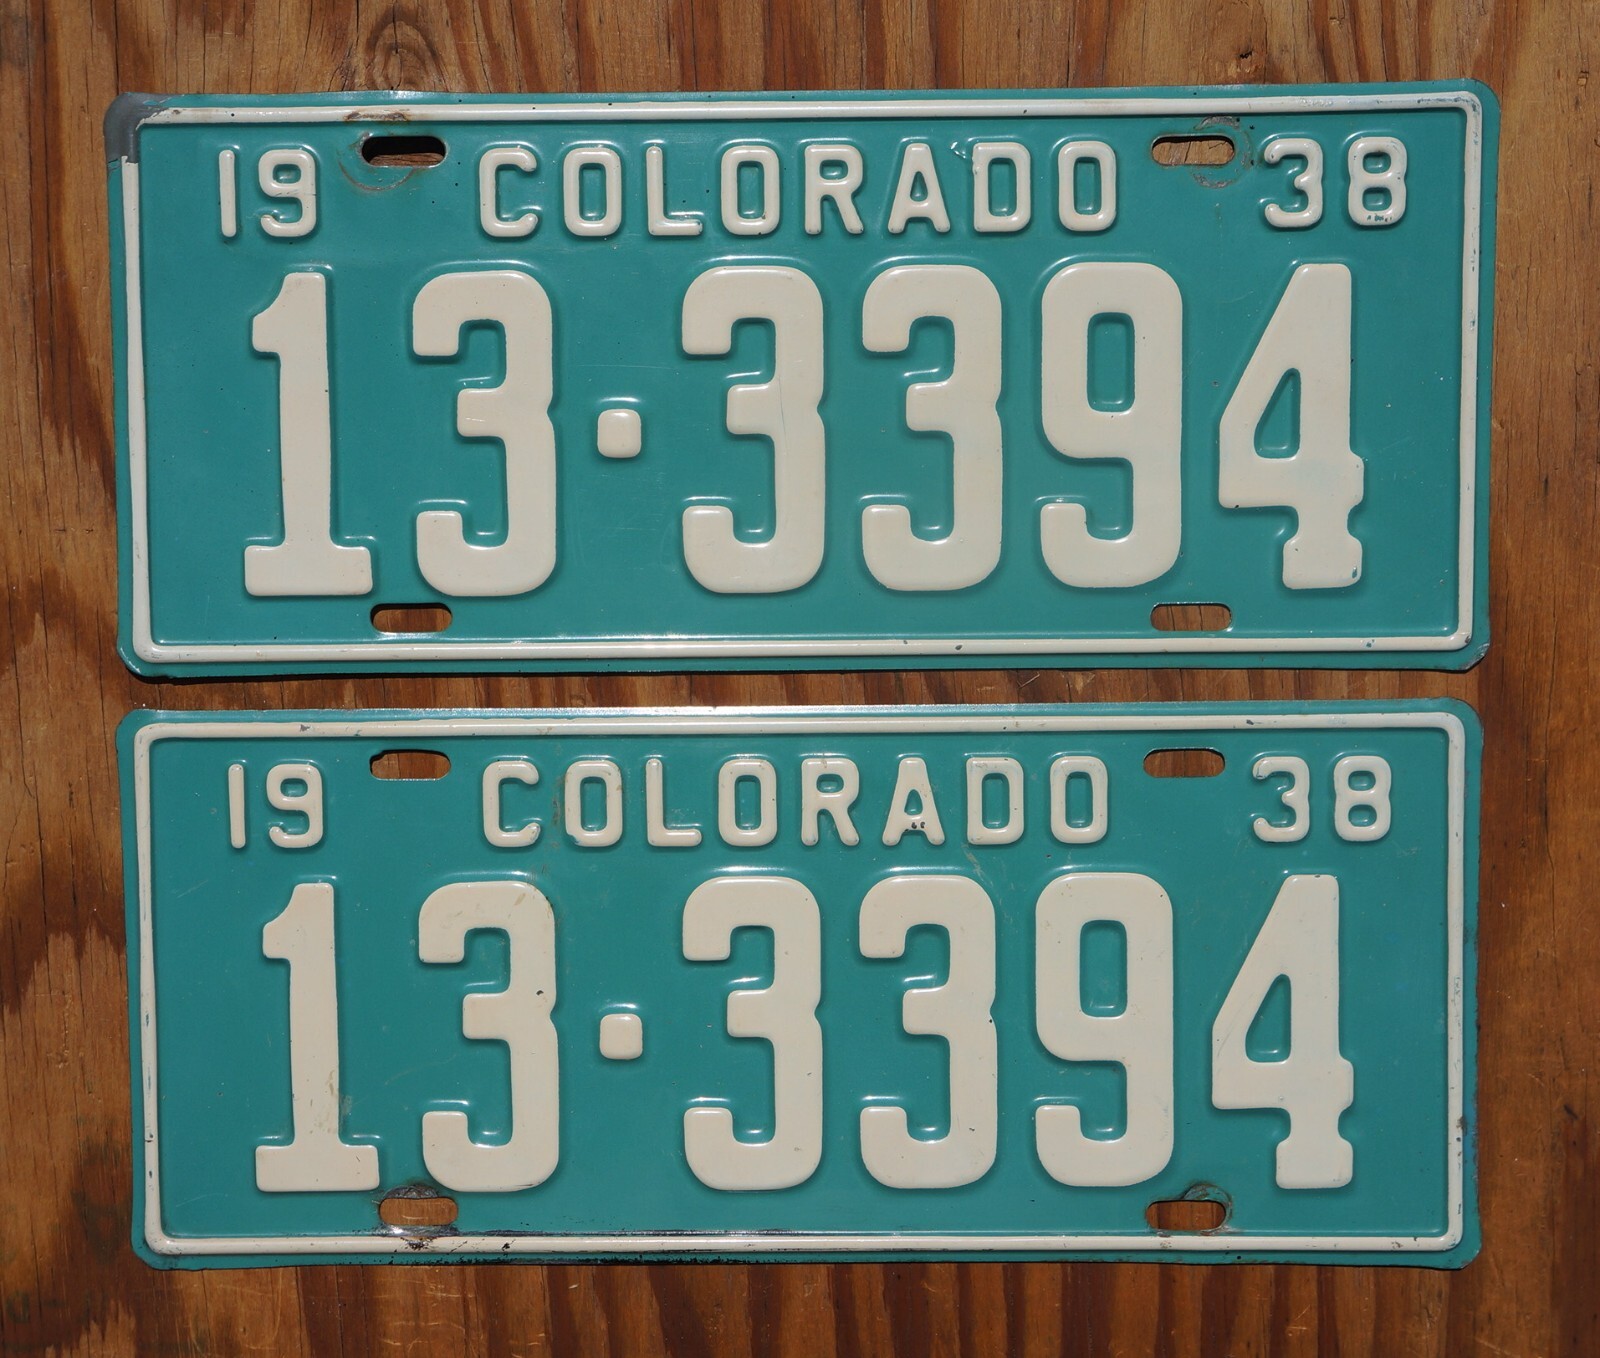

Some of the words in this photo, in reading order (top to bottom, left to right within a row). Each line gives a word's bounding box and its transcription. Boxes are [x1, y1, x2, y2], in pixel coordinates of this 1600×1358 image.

[219, 148, 317, 237] 19
[478, 141, 1117, 237] COLORADO
[1264, 135, 1408, 227] 38
[228, 763, 324, 849] 19
[481, 755, 1109, 848] COLORADO
[1252, 755, 1392, 843] 38
